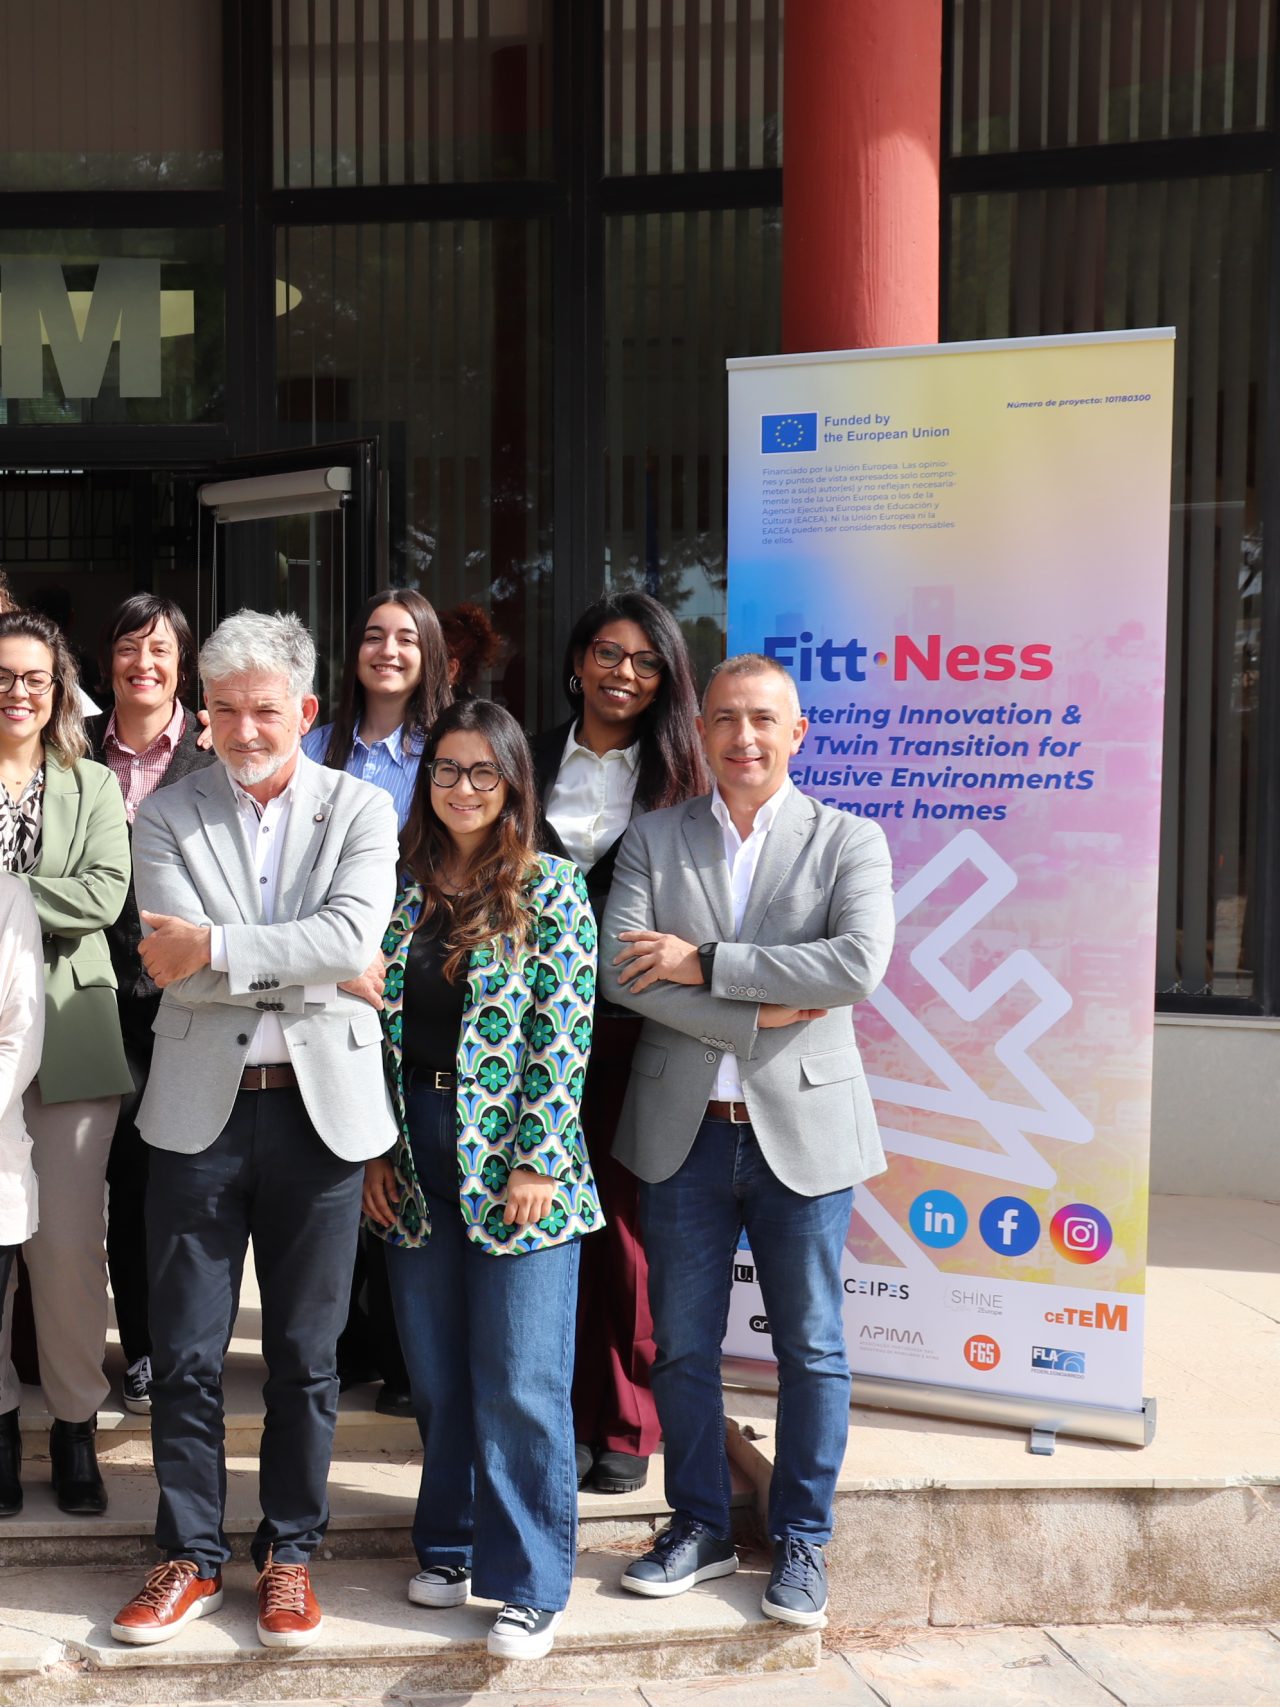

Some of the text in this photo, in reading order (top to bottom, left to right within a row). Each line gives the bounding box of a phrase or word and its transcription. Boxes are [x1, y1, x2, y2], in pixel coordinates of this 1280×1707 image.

[1007, 394, 1151, 408] Número de proyecto: 101180300
[824, 413, 891, 426] Funded by
[824, 427, 950, 444] the European Union
[762, 466, 808, 476] Financiado
[810, 467, 824, 476] por
[825, 464, 833, 472] la
[902, 461, 917, 469] Las
[778, 479, 784, 487] y
[785, 477, 815, 486] puntos
[816, 475, 827, 483] de
[849, 472, 898, 482] expresados
[900, 471, 918, 479] solo
[762, 487, 790, 496] meten
[877, 481, 910, 491] reflejan
[762, 497, 790, 505] mente
[791, 495, 802, 504] los
[804, 495, 815, 503] de
[816, 494, 824, 503] la
[852, 493, 889, 503] Europea
[898, 491, 911, 500] los
[912, 491, 925, 499] de
[926, 491, 934, 499] la
[762, 507, 796, 517] Agencia
[797, 505, 834, 515] Ejecutiva
[836, 503, 871, 513] Europea
[873, 502, 885, 511] de
[762, 517, 793, 526] Cultura
[831, 515, 840, 523] Ni
[841, 513, 849, 522] la
[880, 512, 916, 522] Europea
[917, 511, 926, 519] ni
[927, 511, 936, 519] la
[762, 520, 956, 536] EACEA pueden ser considerados responsables
[761, 536, 773, 545] de
[801, 703, 1083, 730] tering Innovation &
[814, 734, 879, 756] Twin
[889, 735, 1031, 757] Transition
[1039, 736, 1081, 757] for
[789, 765, 1095, 790] clusive EnvironmentS
[912, 798, 1007, 821] homes
[843, 1278, 910, 1300] CEIPES
[951, 1289, 1003, 1309] SHINE
[859, 1325, 924, 1346] APIMA
[1033, 1347, 1059, 1362] FLA
